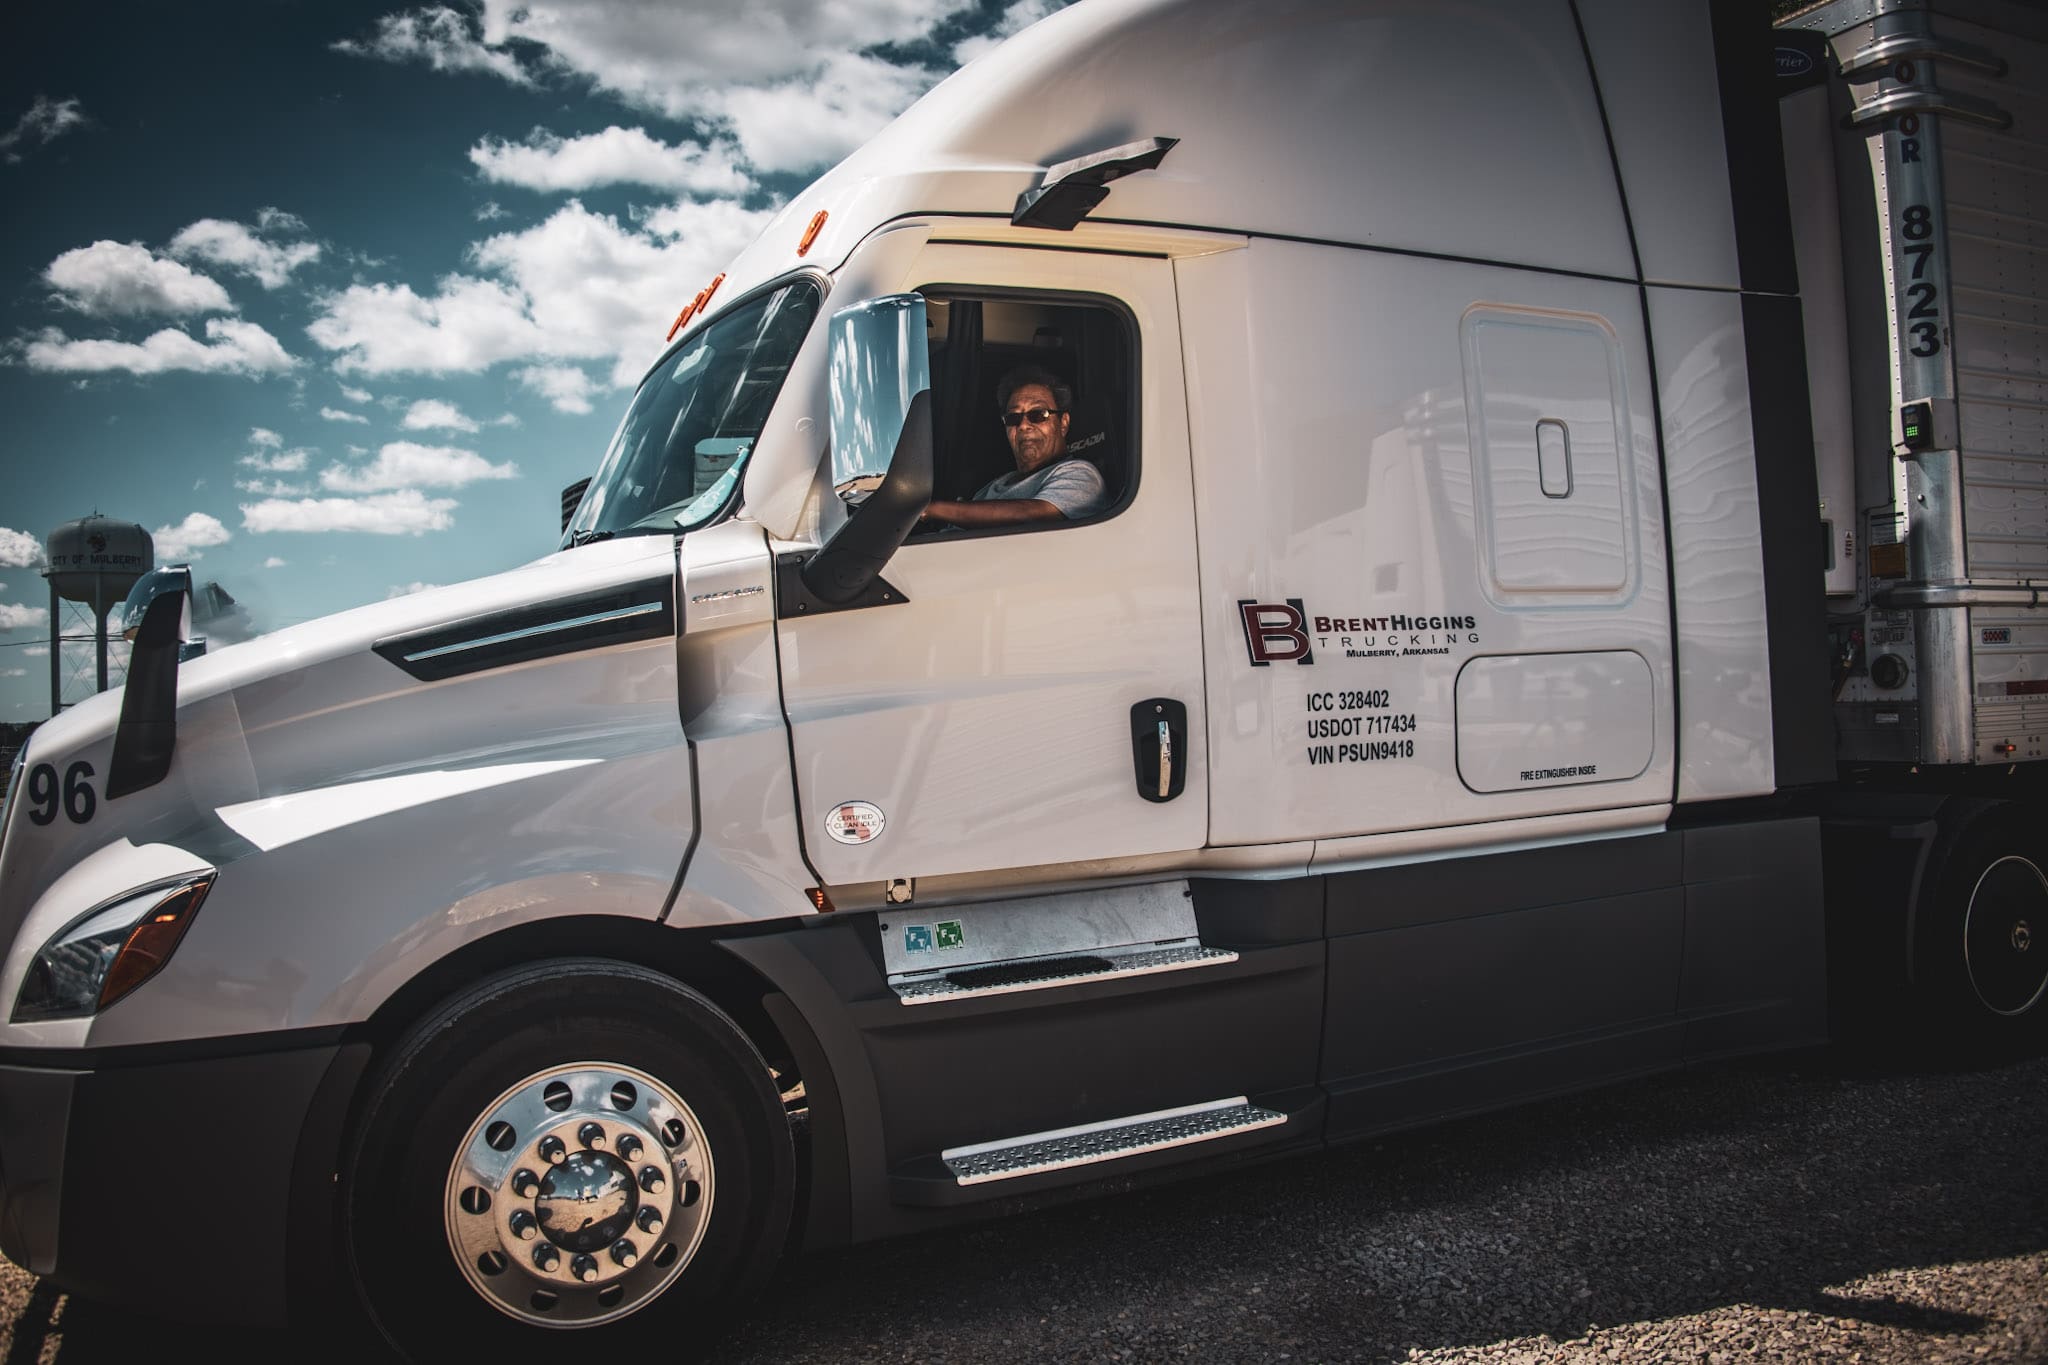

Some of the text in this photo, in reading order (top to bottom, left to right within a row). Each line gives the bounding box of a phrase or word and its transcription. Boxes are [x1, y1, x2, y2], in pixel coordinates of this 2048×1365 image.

[1902, 204, 1941, 358] 8723
[72, 554, 84, 565] OF
[90, 554, 142, 568] MULBERRY
[1318, 633, 1480, 648] TRUCKING
[1307, 690, 1390, 712] ICC 328402
[1308, 714, 1416, 738] USDOT 717434
[1308, 740, 1414, 765] VIN PSUN9418
[1520, 765, 1596, 781] FIRE EXTINGUISHER INSIDE
[28, 760, 97, 827] 96
